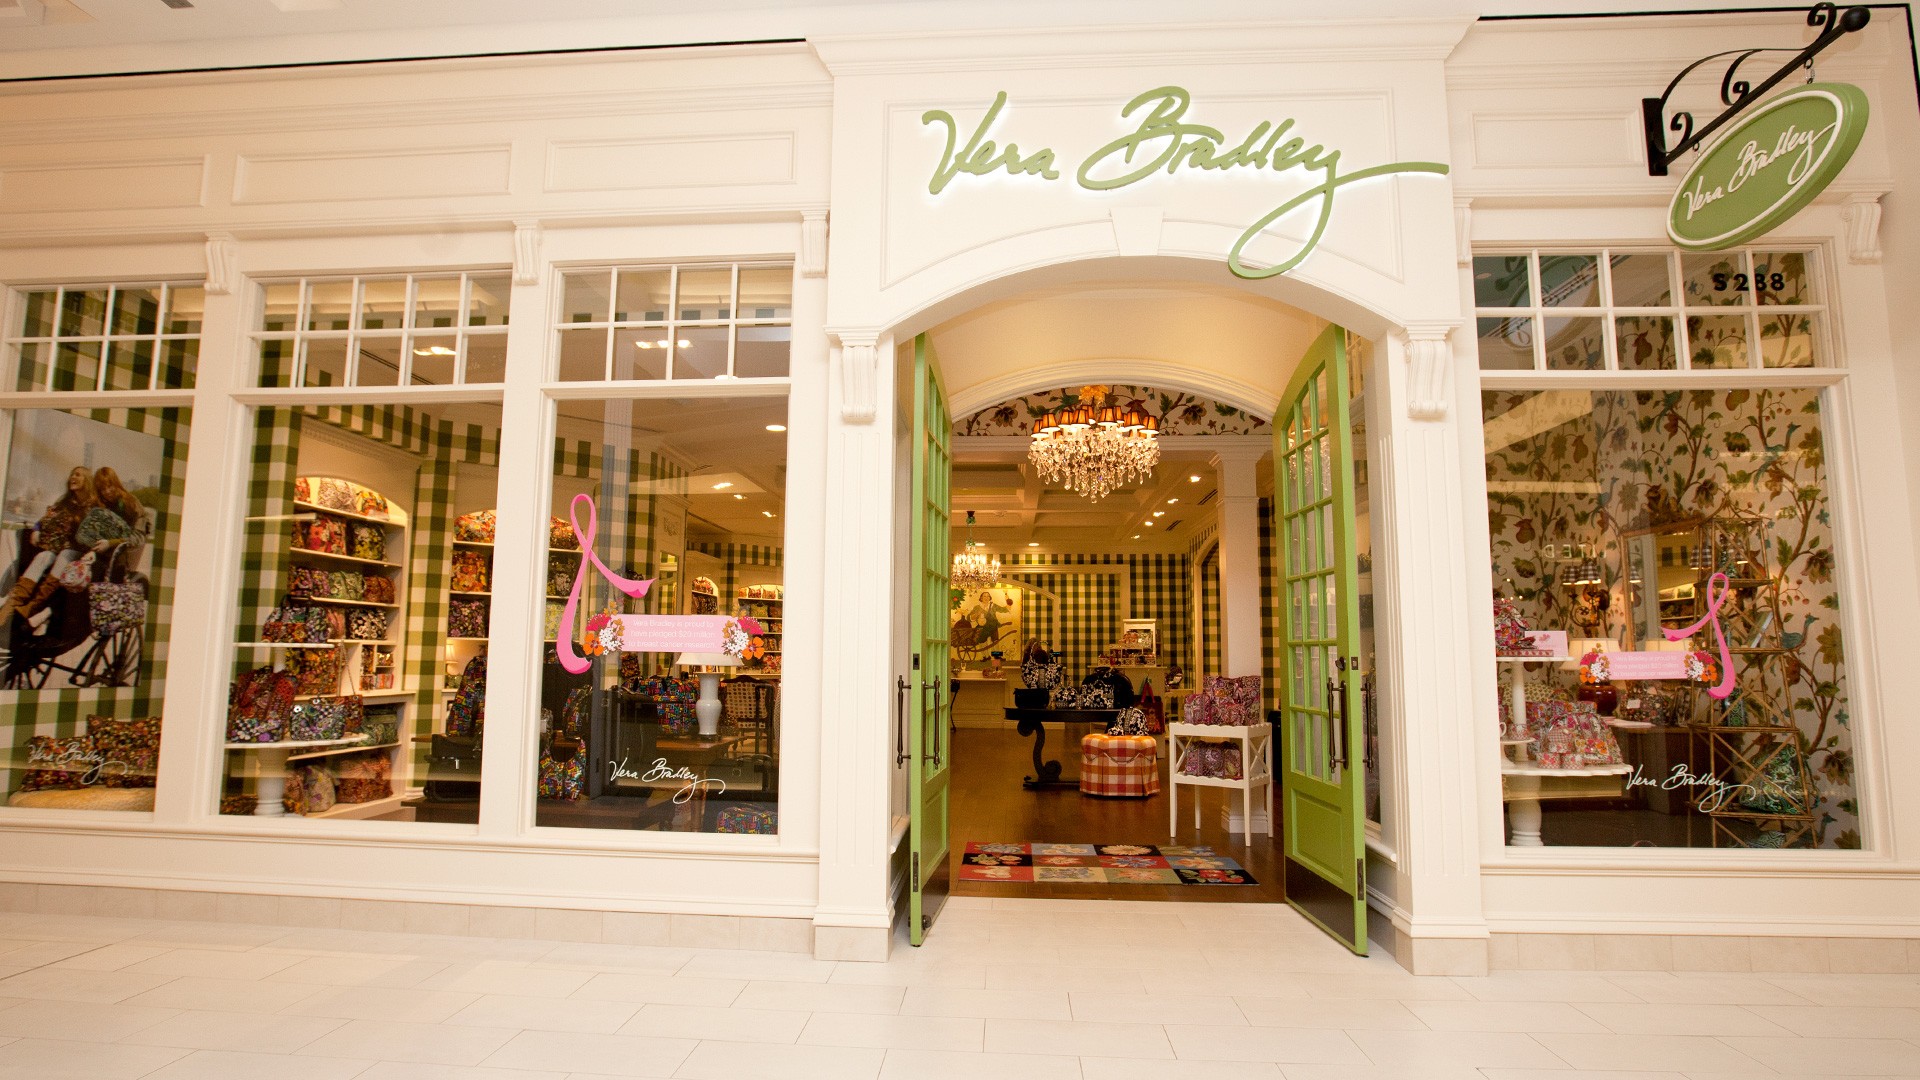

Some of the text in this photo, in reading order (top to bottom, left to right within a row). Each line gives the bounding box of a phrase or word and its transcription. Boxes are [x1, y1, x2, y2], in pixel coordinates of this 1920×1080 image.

[921, 86, 1450, 280] Vera Bradley
[1683, 121, 1836, 221] Vera Bradley
[28, 742, 53, 763] Vera
[609, 757, 726, 804] Vera Bradley
[1626, 764, 1756, 813] Vera Bradley
